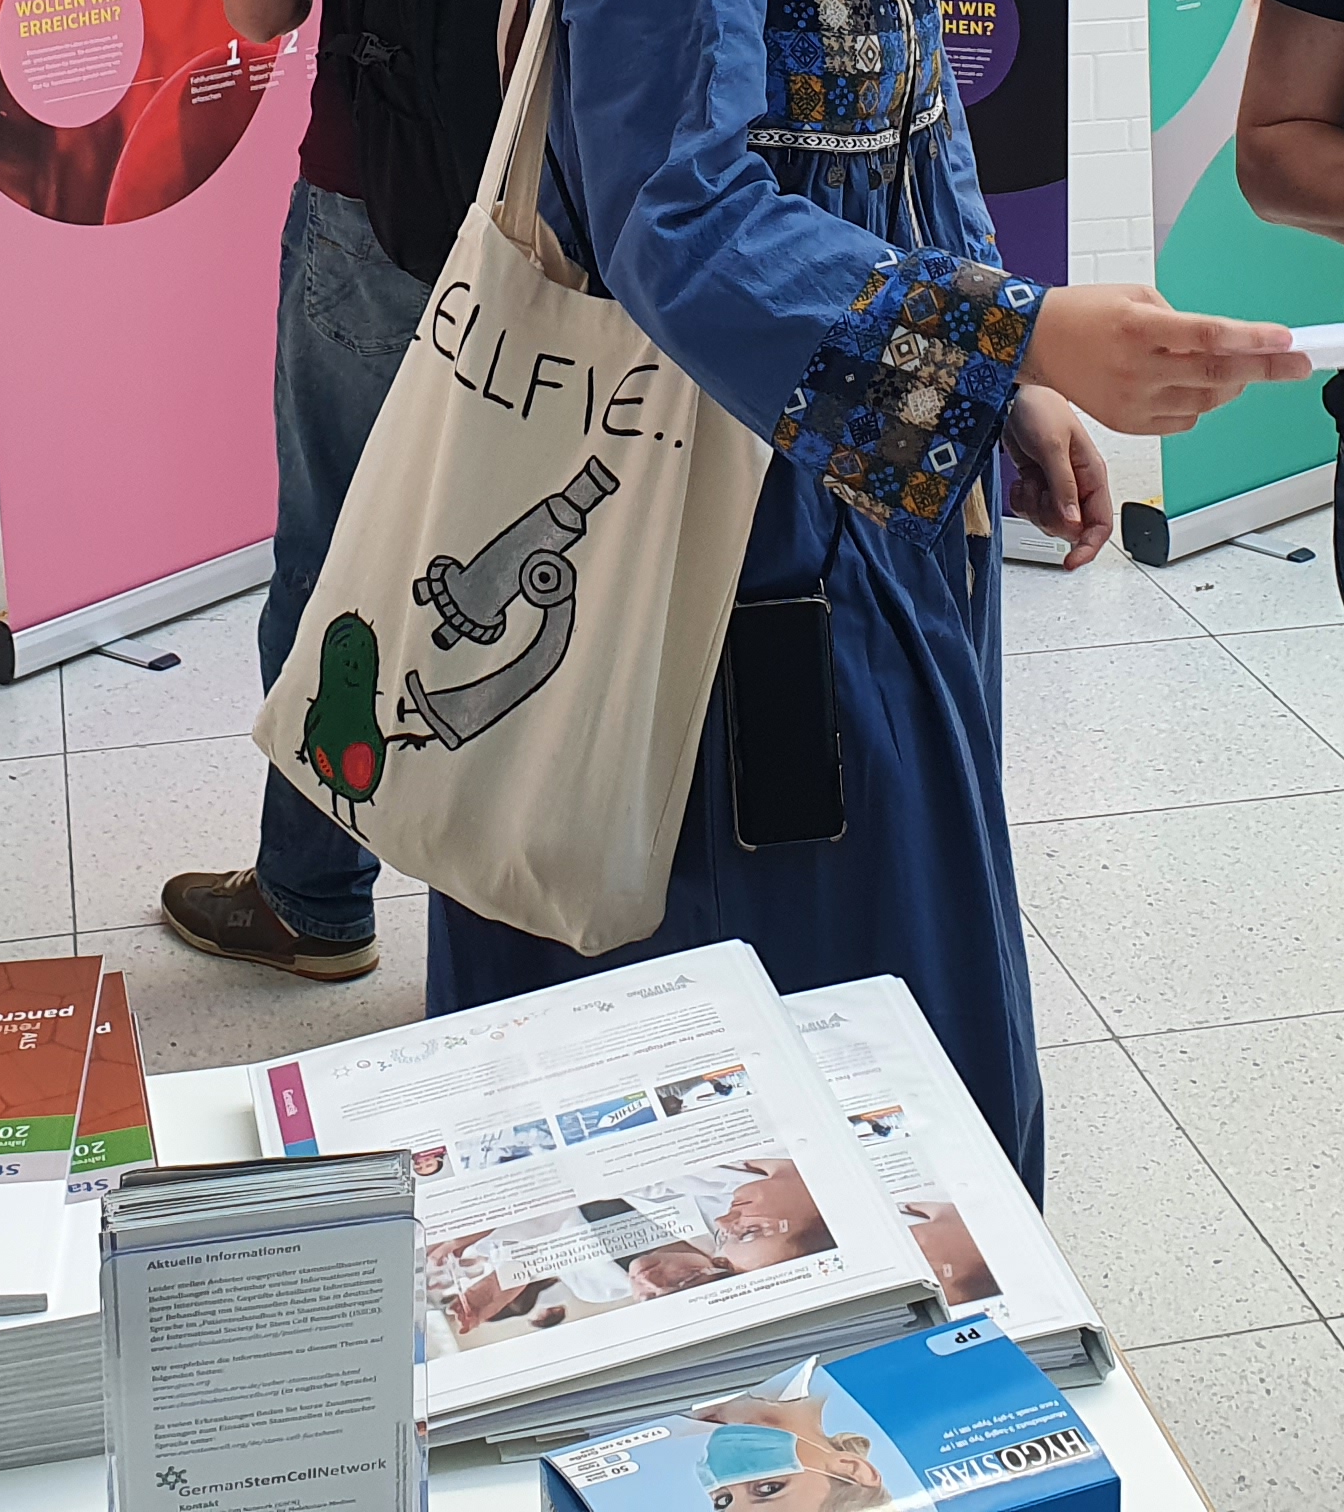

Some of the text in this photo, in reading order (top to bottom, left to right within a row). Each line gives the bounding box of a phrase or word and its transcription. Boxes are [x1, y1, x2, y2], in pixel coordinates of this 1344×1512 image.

[19, 6, 121, 38] ERREICHEN?
[226, 38, 241, 66] 1
[418, 281, 683, 449] ELLFIE..
[18, 1032, 38, 1051] ALS
[146, 1244, 302, 1271] Aktuelle Informationen
[954, 1327, 982, 1346] PP
[611, 1464, 630, 1476] 50
[929, 1429, 1088, 1491] HYGOSTAR
[178, 1457, 387, 1498] GermanStemCellNetwork
